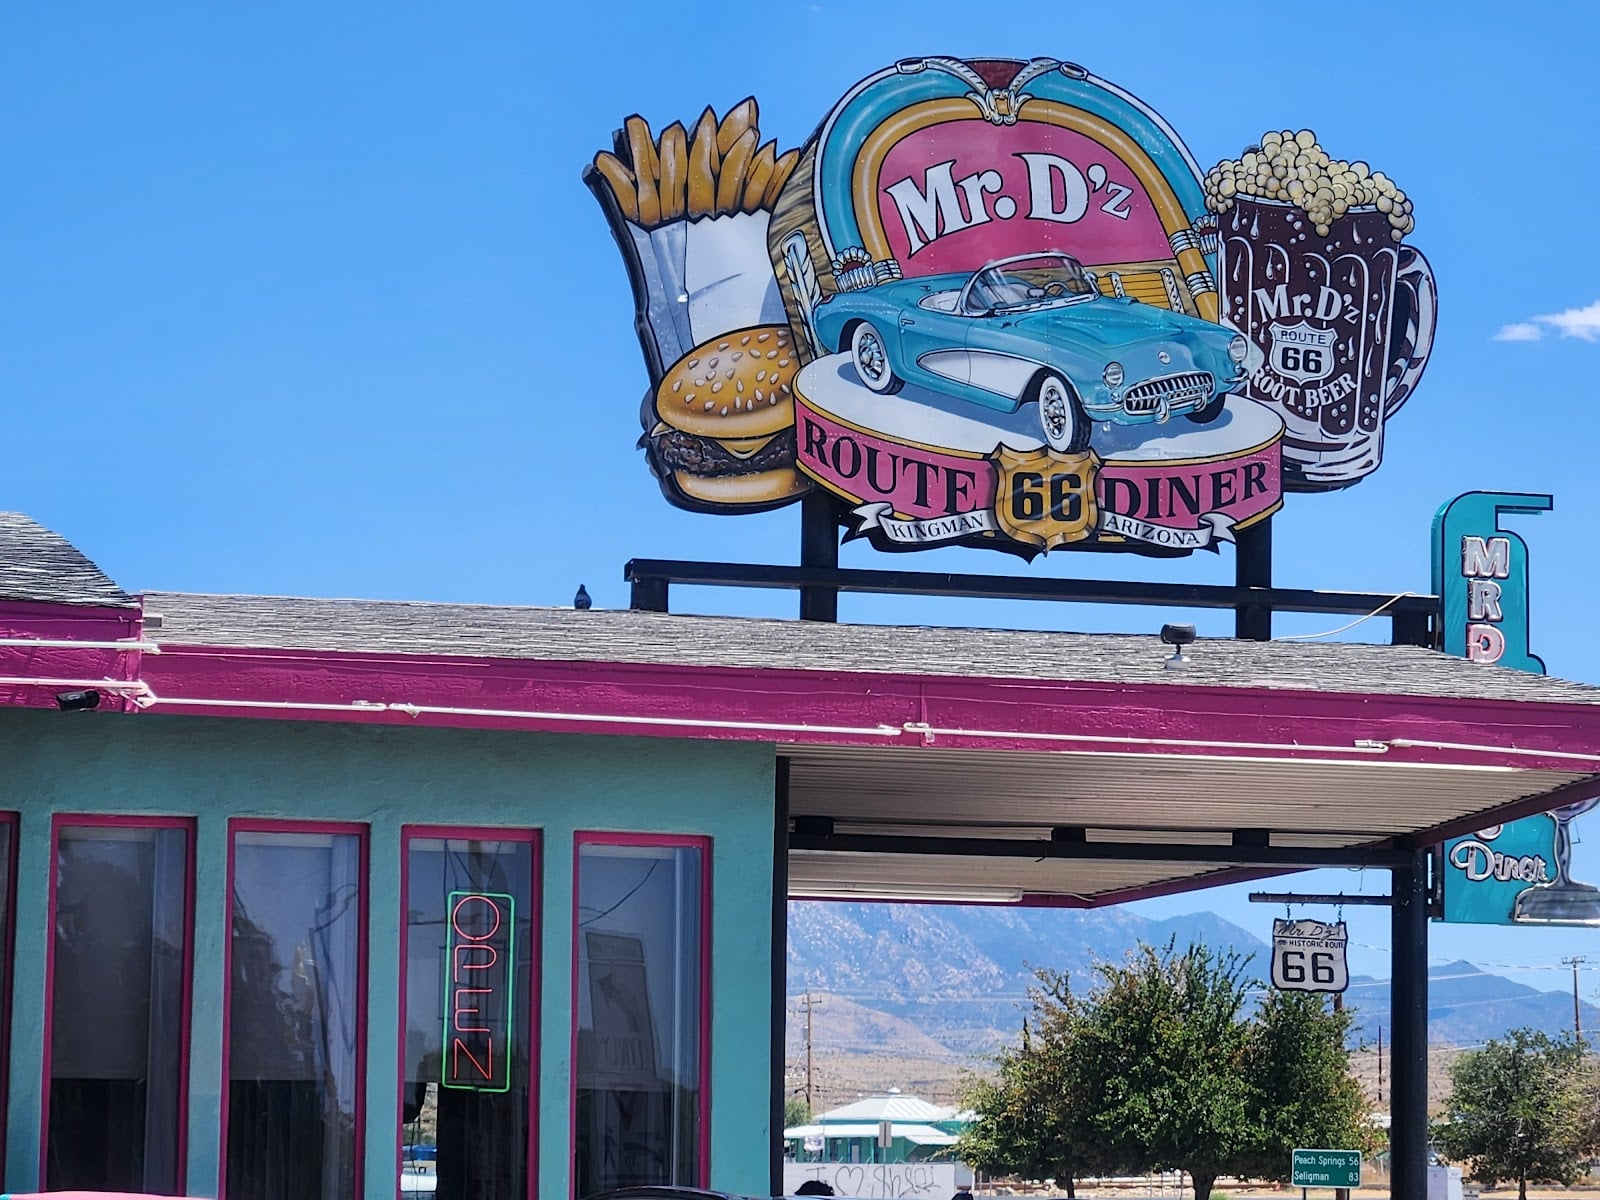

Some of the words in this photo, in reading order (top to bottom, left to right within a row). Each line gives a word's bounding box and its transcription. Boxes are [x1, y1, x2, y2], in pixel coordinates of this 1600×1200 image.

[886, 161, 1017, 257] Mr.
[1017, 152, 1133, 222] D'z
[1254, 284, 1313, 325] Mr.
[1281, 330, 1326, 344] ROUTE
[1281, 347, 1323, 374] 66
[1253, 367, 1301, 407] ROOT
[1304, 372, 1358, 409] BEER
[804, 418, 979, 512] ROUTE
[1011, 471, 1082, 523] 66
[1102, 461, 1268, 520] DINER
[889, 513, 985, 540] KINGMAN
[1104, 514, 1200, 545] ARIZONA
[1450, 840, 1549, 883] Diner
[1289, 939, 1324, 948] HISTORIC
[1282, 952, 1334, 983] 66
[453, 895, 499, 1081] OPEN
[1294, 1155, 1316, 1166] Peach
[1318, 1155, 1346, 1168] Springs
[1348, 1156, 1359, 1166] 56
[1294, 1171, 1329, 1182] Seligman
[1348, 1172, 1359, 1182] 83
